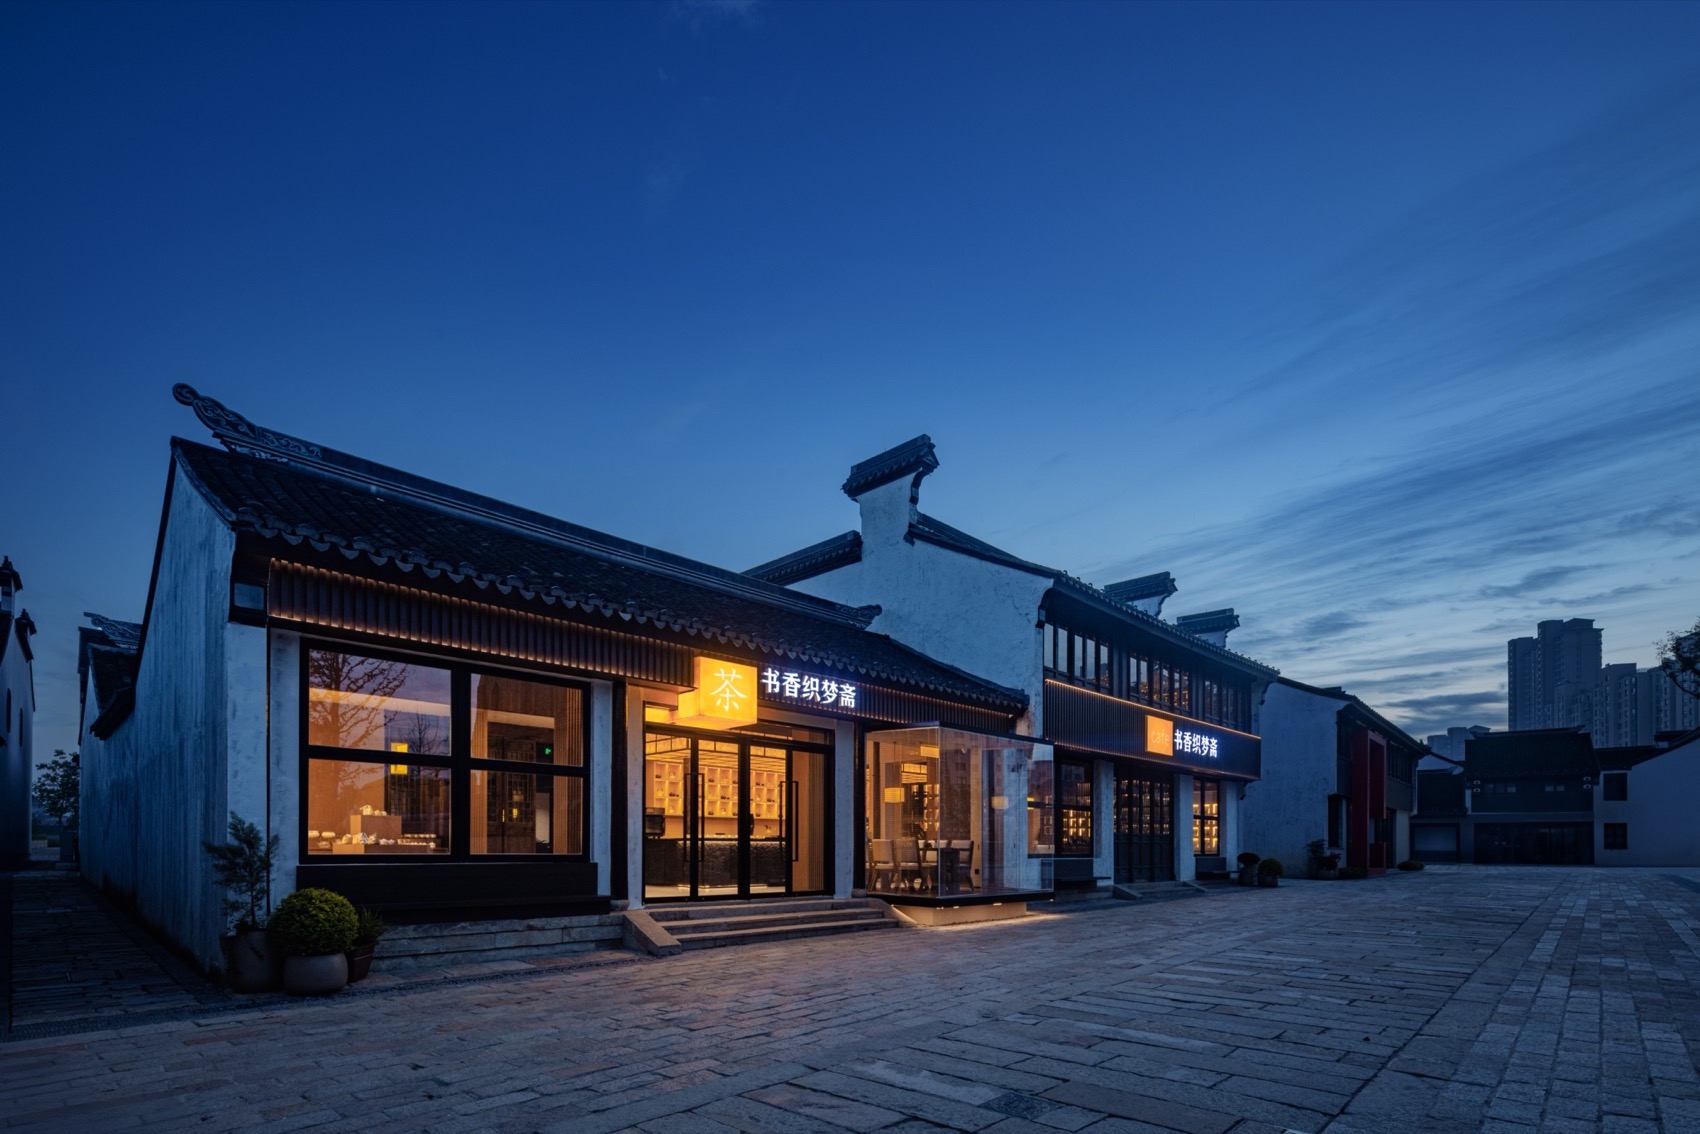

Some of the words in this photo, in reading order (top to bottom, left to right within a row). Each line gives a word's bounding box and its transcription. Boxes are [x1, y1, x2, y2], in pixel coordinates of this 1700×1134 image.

[710, 667, 748, 712] 茶
[761, 667, 857, 709] 书香织梦斋
[1151, 728, 1170, 746] cafe
[1174, 729, 1218, 758] 书香织梦斋
